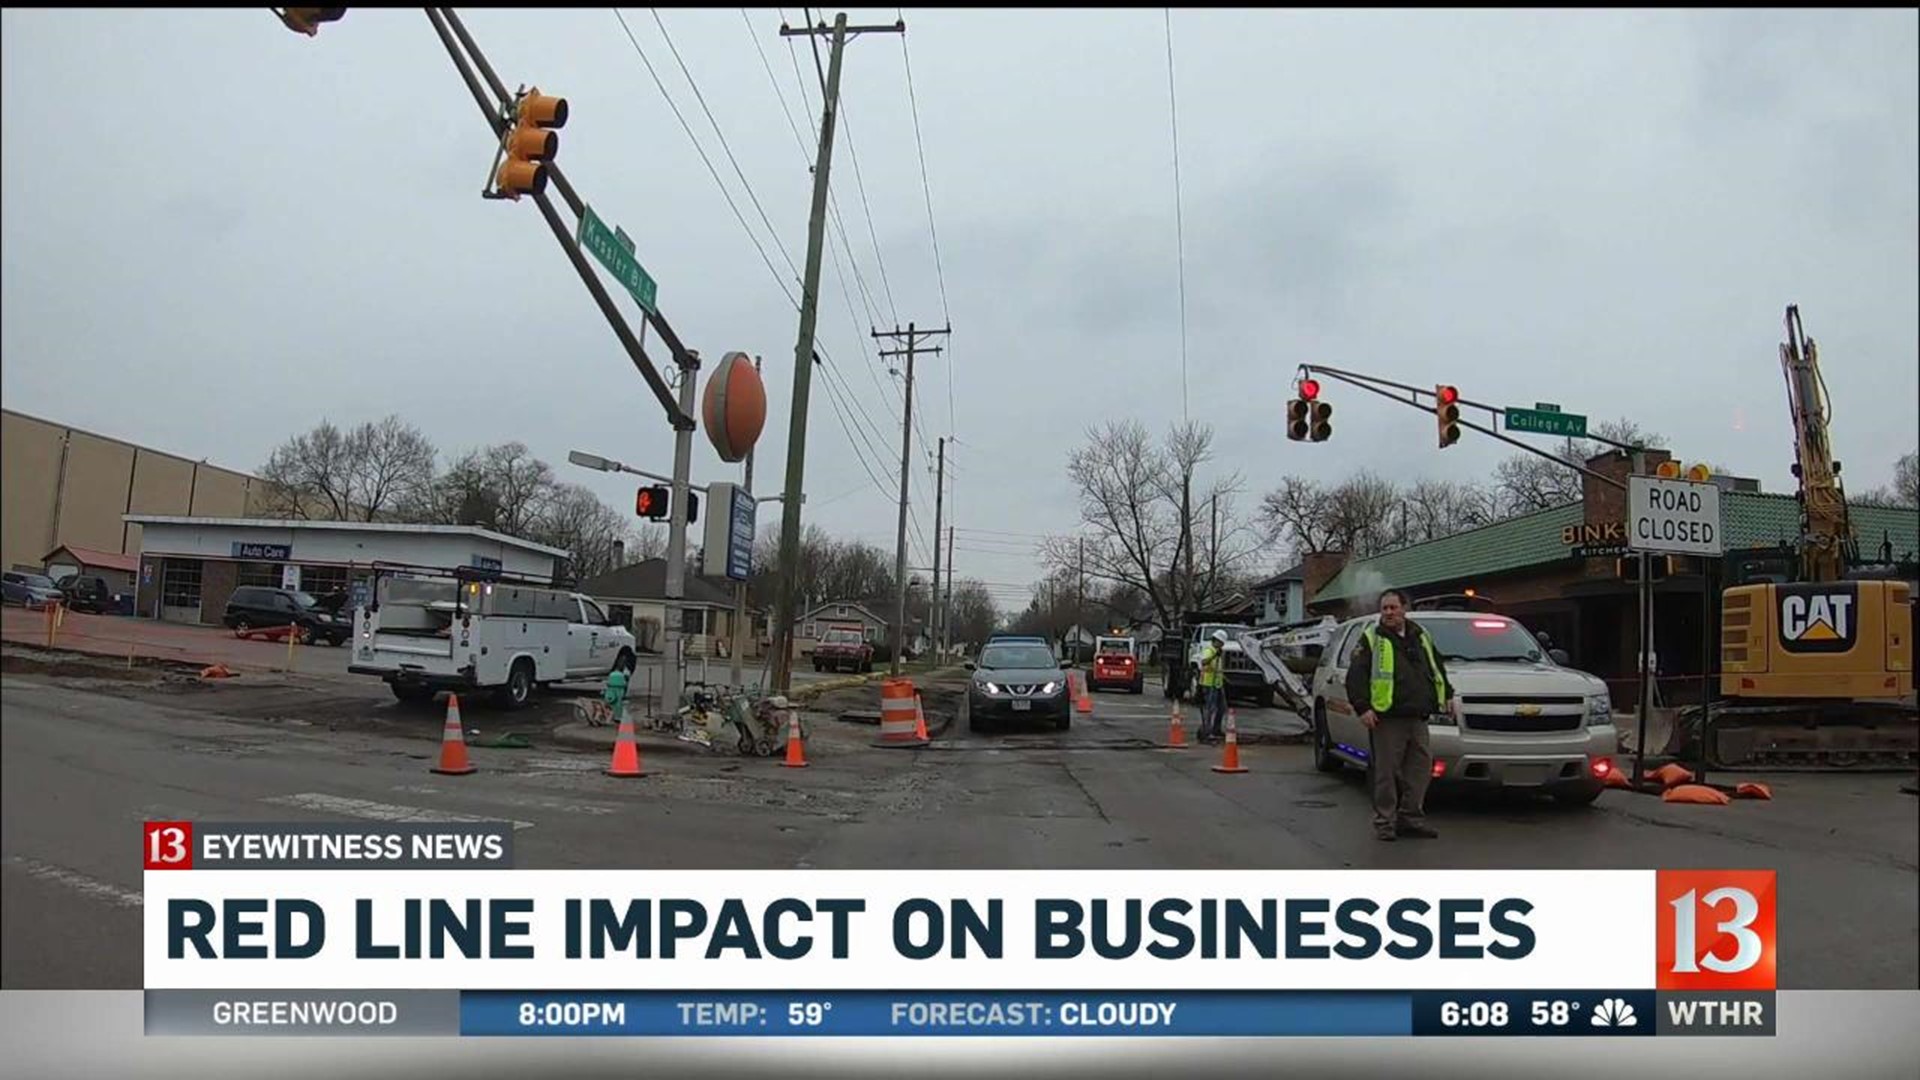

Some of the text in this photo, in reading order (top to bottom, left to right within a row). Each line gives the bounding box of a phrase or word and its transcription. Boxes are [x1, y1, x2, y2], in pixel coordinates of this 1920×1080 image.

[586, 220, 628, 275] Kessler
[1510, 413, 1582, 432] College Av
[1649, 487, 1701, 513] ROAD
[1637, 516, 1714, 544] CLOSED
[242, 545, 285, 558] Auto Care
[1782, 594, 1852, 641] CAT
